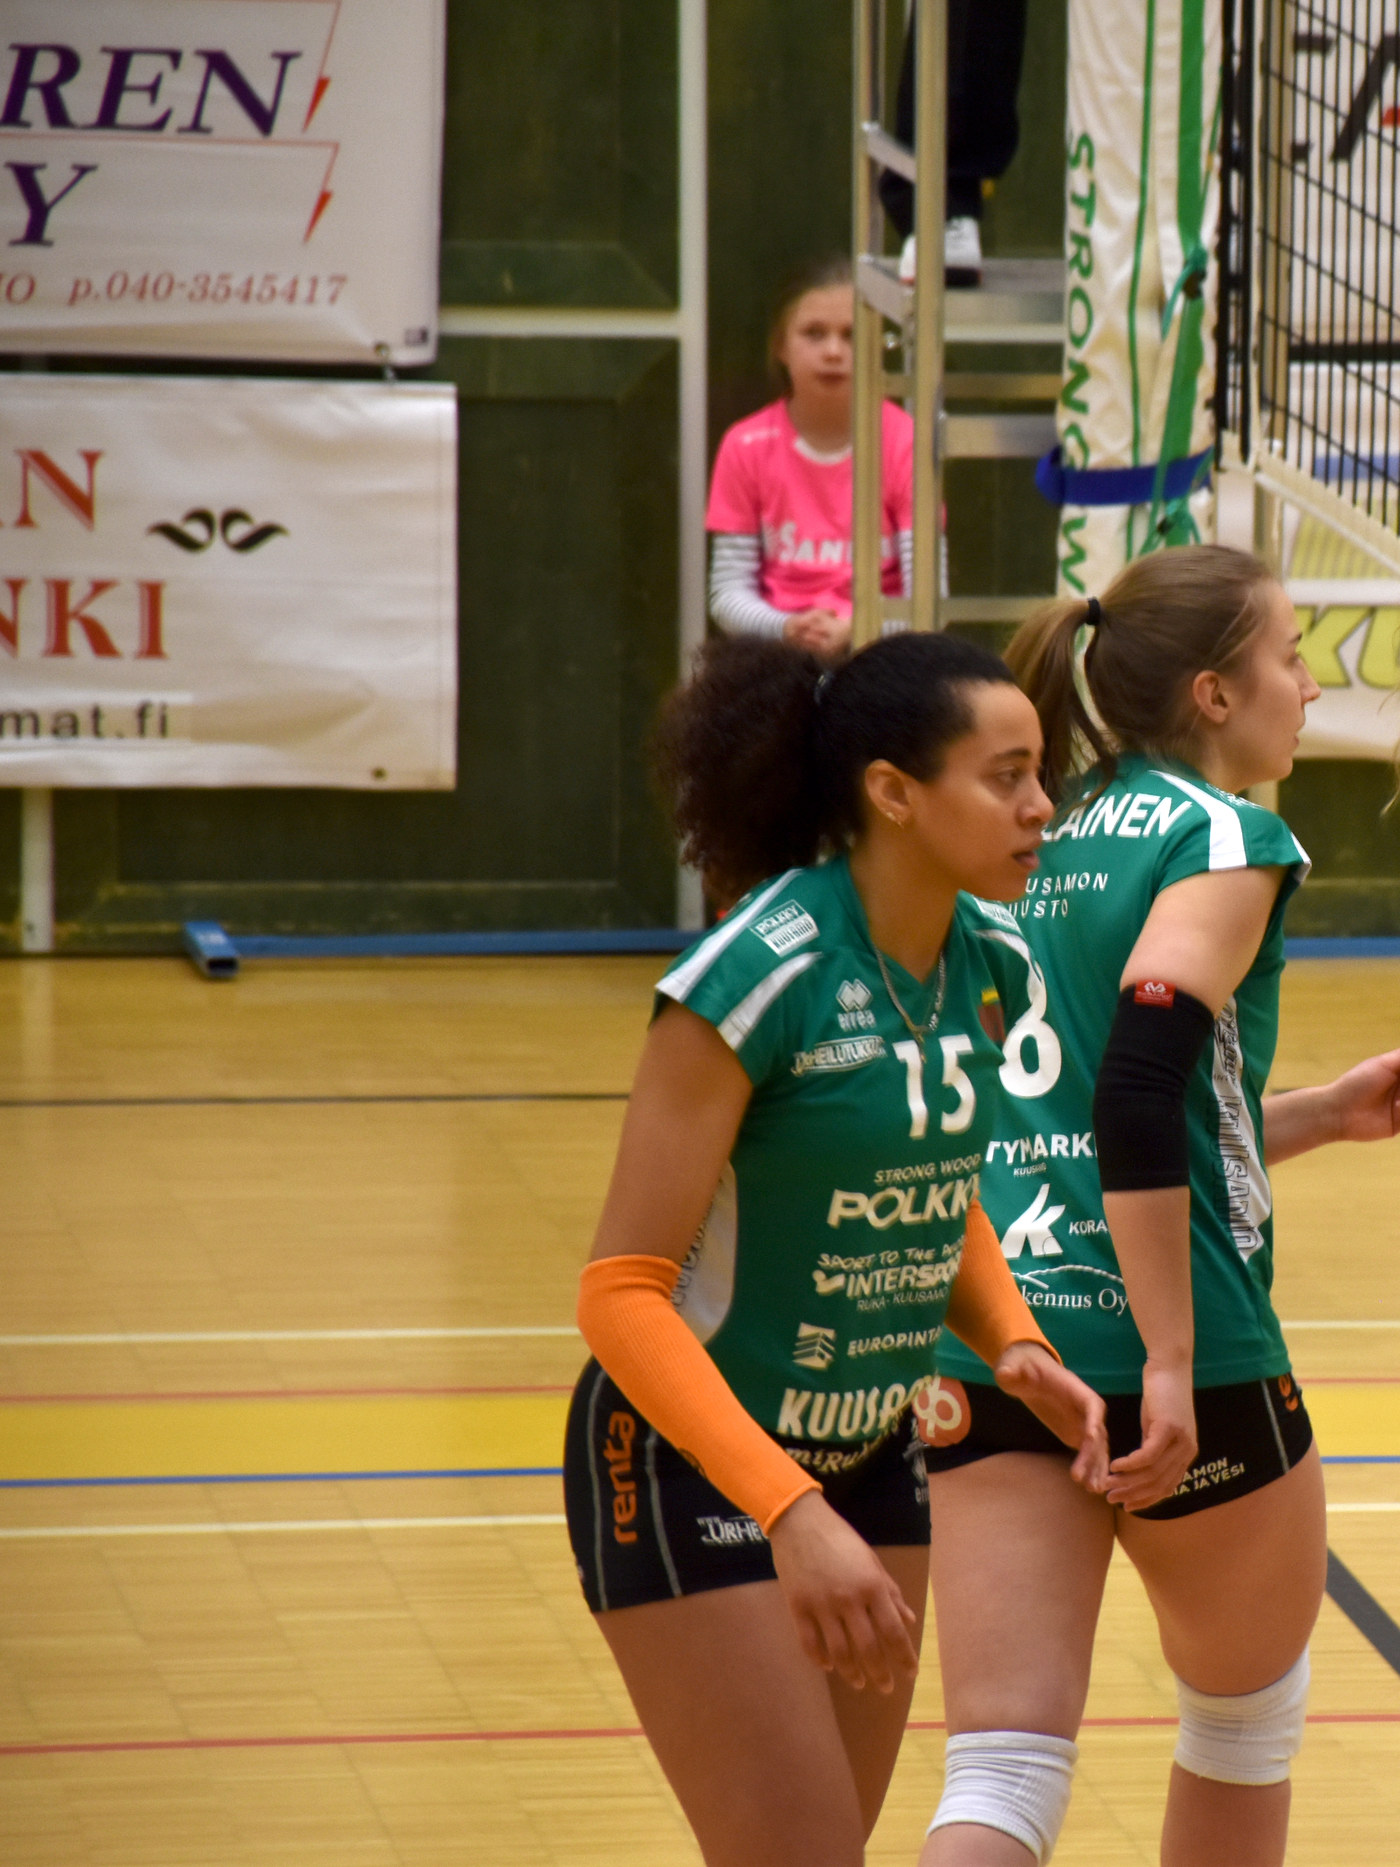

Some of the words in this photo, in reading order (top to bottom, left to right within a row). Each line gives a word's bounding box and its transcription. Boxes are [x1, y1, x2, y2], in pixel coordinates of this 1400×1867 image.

[0, 43, 302, 138] REN
[3, 160, 98, 248] Y
[0, 272, 37, 303] O
[0, 448, 104, 532] N
[1059, 515, 1088, 595] W
[892, 1034, 977, 1140] 15
[874, 1162, 937, 1187] STRONG
[985, 1131, 1098, 1165] TYMARK
[879, 1250, 900, 1266] TO
[1069, 1219, 1111, 1236] KORA
[603, 1410, 639, 1545] renta
